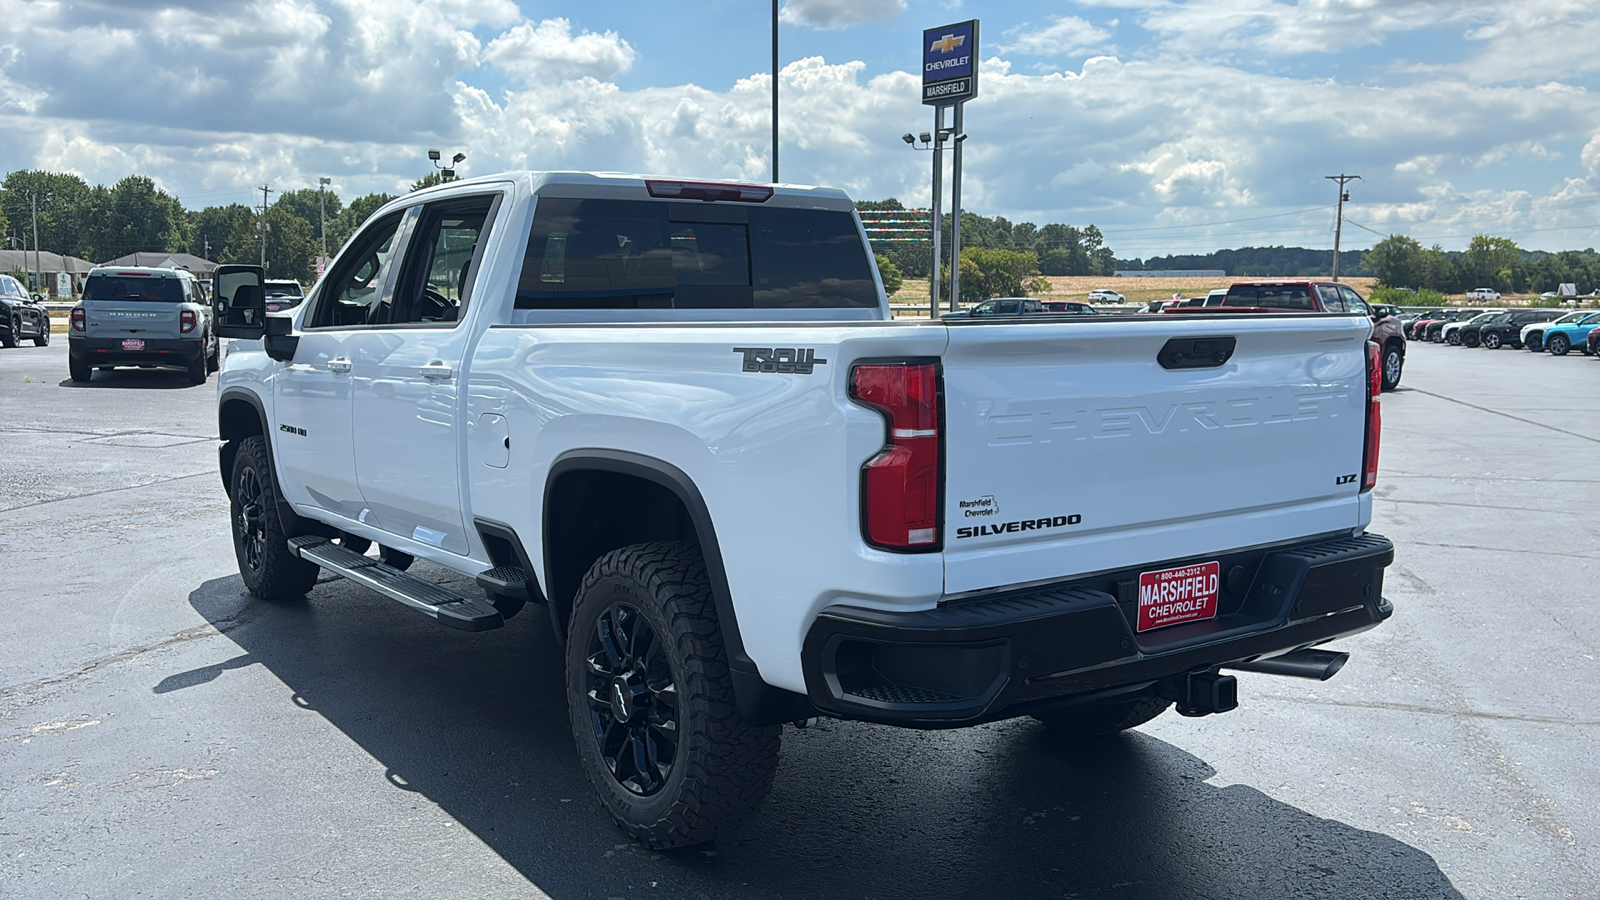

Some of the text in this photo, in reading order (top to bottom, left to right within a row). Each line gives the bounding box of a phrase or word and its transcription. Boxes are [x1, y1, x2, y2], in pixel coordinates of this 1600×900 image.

[926, 56, 969, 71] CHEVROLET
[927, 82, 965, 97] MARSHFIELD
[733, 347, 827, 364] TRAIL
[742, 361, 813, 374] BOSS
[987, 390, 1348, 447] CHEVROLET
[1336, 473, 1357, 485] LTZ
[959, 498, 991, 508] Marshfield
[965, 508, 993, 517] Chevrolet
[956, 514, 1082, 539] SILVERADO
[1161, 567, 1201, 580] 800-440-2312
[1141, 574, 1218, 606] MARSHFIELD
[1148, 597, 1209, 619] CHEVROLET
